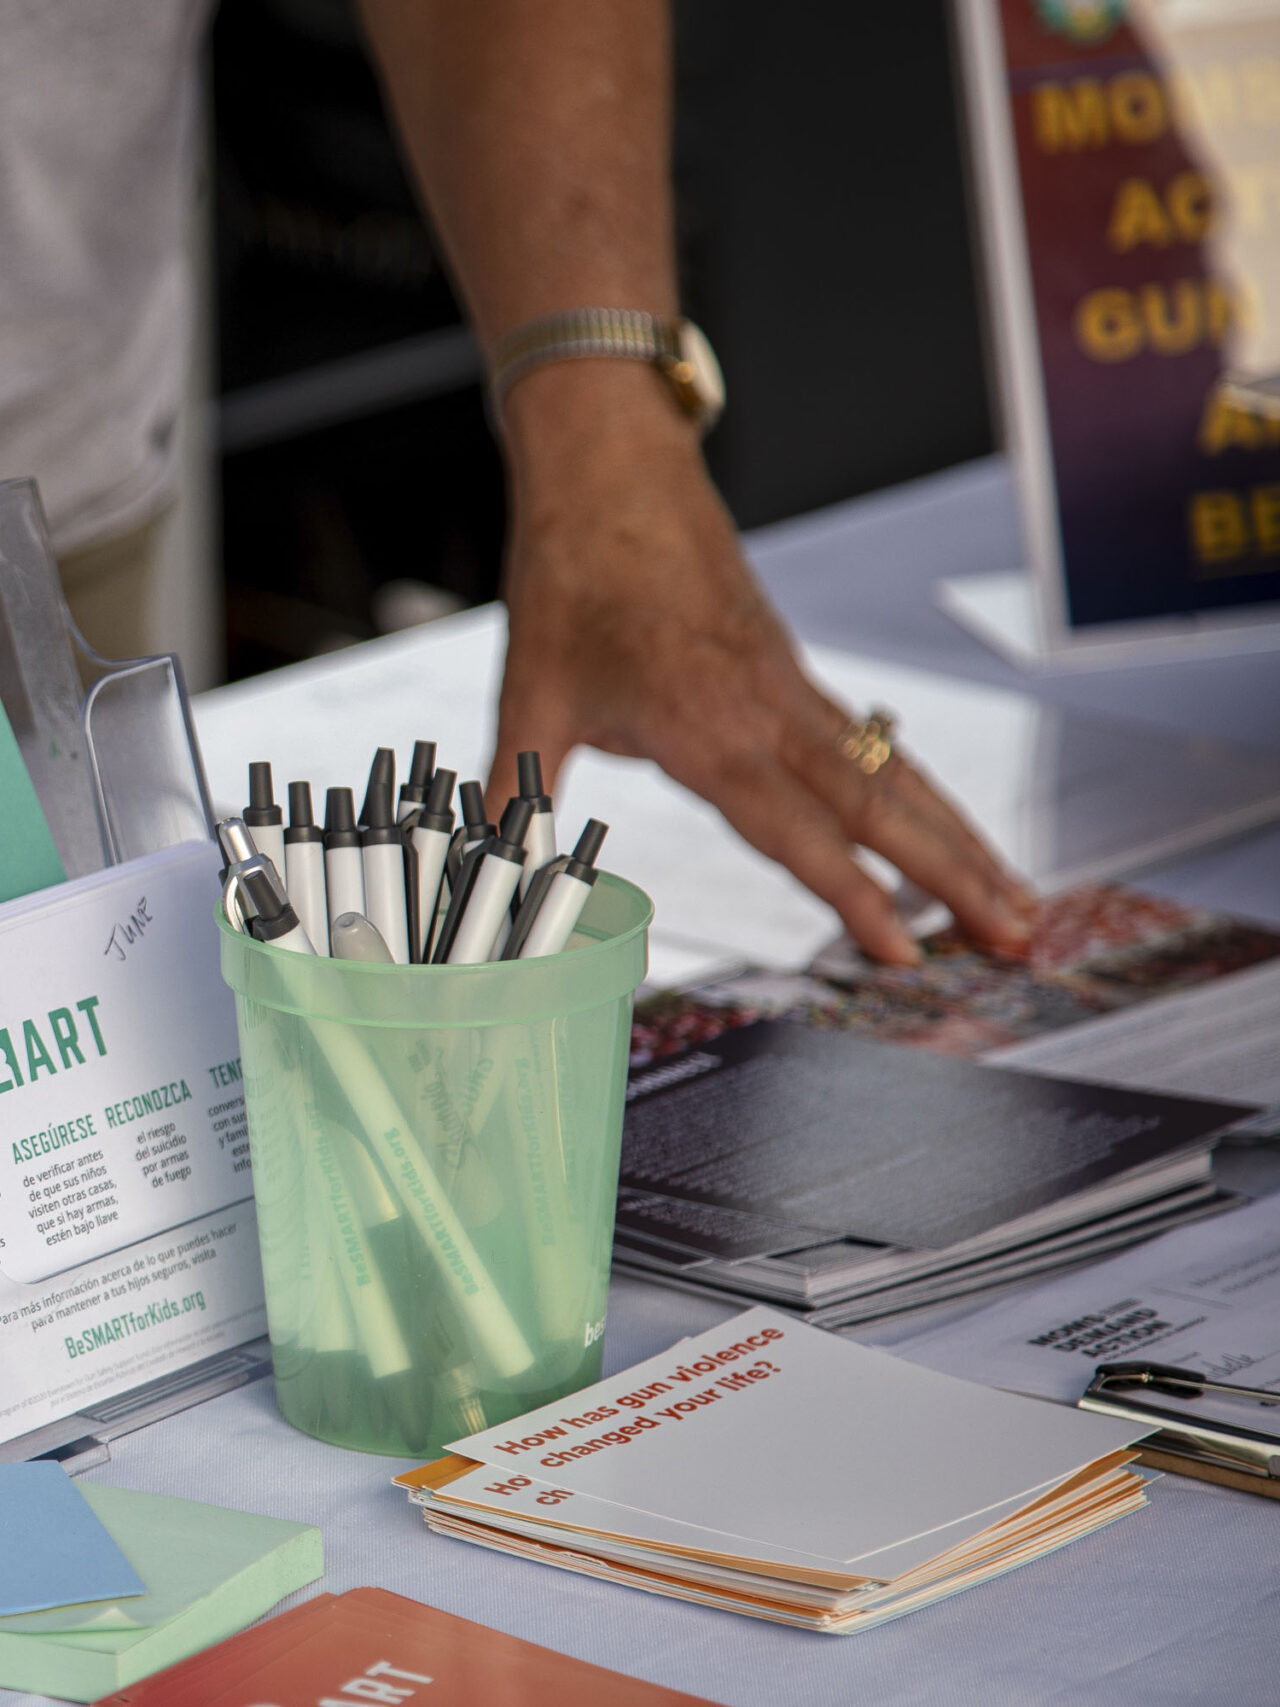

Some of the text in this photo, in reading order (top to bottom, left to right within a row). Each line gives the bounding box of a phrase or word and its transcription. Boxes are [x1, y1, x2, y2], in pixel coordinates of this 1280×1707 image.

[104, 895, 154, 961] JUNE
[11, 1078, 194, 1165] ASEGÚRESE RECONOZCA
[136, 1121, 177, 1145] el riesgo
[135, 1134, 188, 1162] del suicidio
[141, 1149, 190, 1178] por armas
[22, 1149, 105, 1188] de verificar antes
[28, 1165, 108, 1203] de que sus niños
[151, 1165, 193, 1189] de fuego
[27, 1179, 118, 1219] visiten otras casas,
[36, 1194, 119, 1235] que si hay armas,
[45, 1210, 119, 1247] estén bajo llave
[19, 1300, 42, 1318] más
[41, 1278, 100, 1309] información
[101, 1265, 133, 1285] acerca
[132, 1259, 146, 1272] de
[145, 1255, 157, 1266] lo
[157, 1247, 176, 1264] que
[177, 1230, 212, 1257] puedes
[210, 1221, 238, 1247] hacer
[30, 1248, 218, 1334] para mantener a tus hijos seguros, visita
[64, 1289, 207, 1360] BeSMARTforKids.org
[494, 1326, 785, 1455] How has gun violence
[540, 1360, 782, 1468] changed your life?
[484, 1474, 533, 1496] Ho
